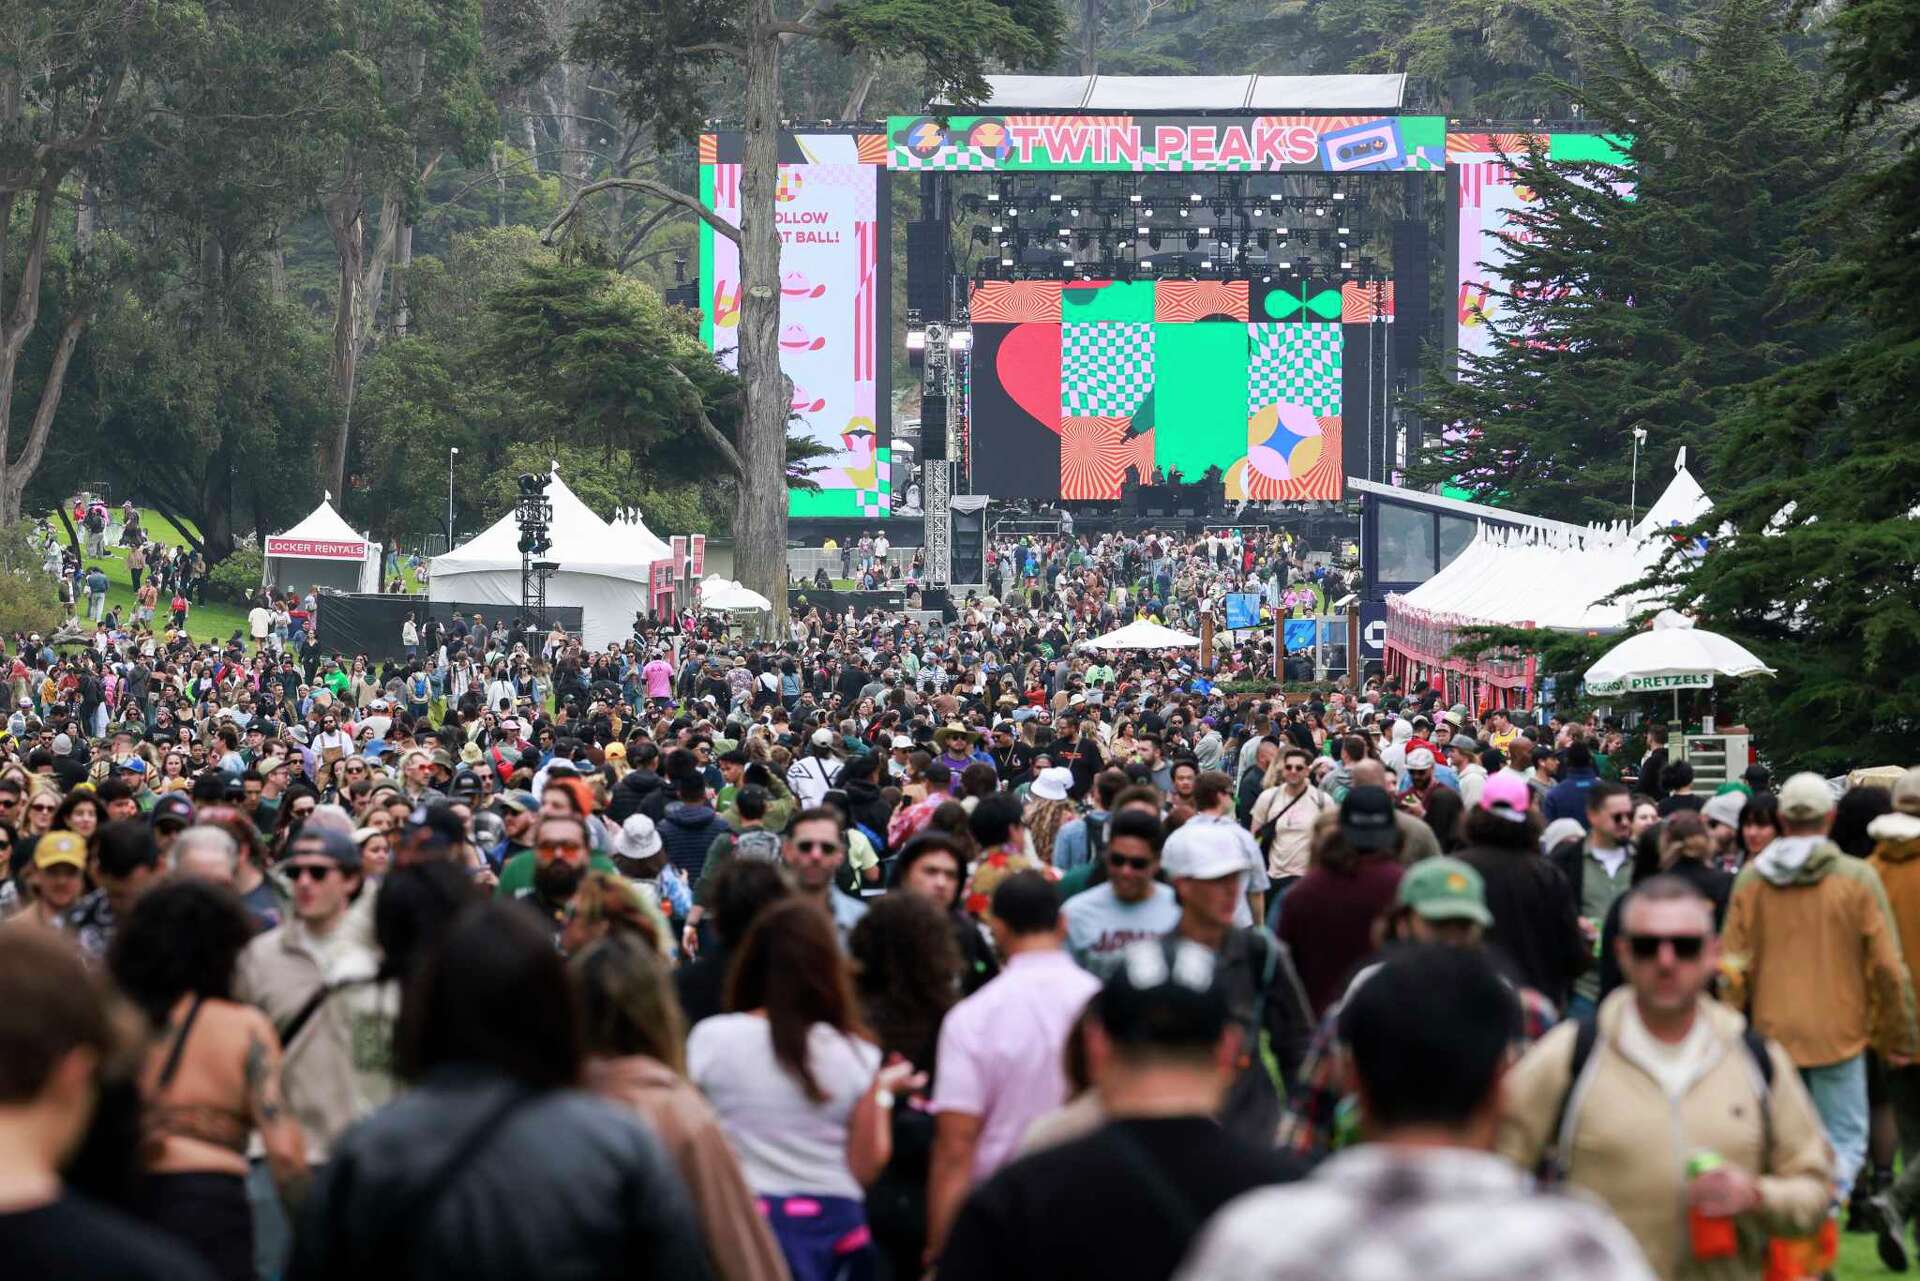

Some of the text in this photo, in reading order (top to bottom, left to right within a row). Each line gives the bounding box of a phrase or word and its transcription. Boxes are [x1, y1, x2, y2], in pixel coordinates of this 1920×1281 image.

[1010, 125, 1319, 163] TWIN PEAKS
[775, 212, 829, 224] OLLOW
[795, 231, 840, 243] BALL!
[269, 542, 364, 554] LOCKER RENTALS
[1631, 674, 1709, 688] PRETZELS
